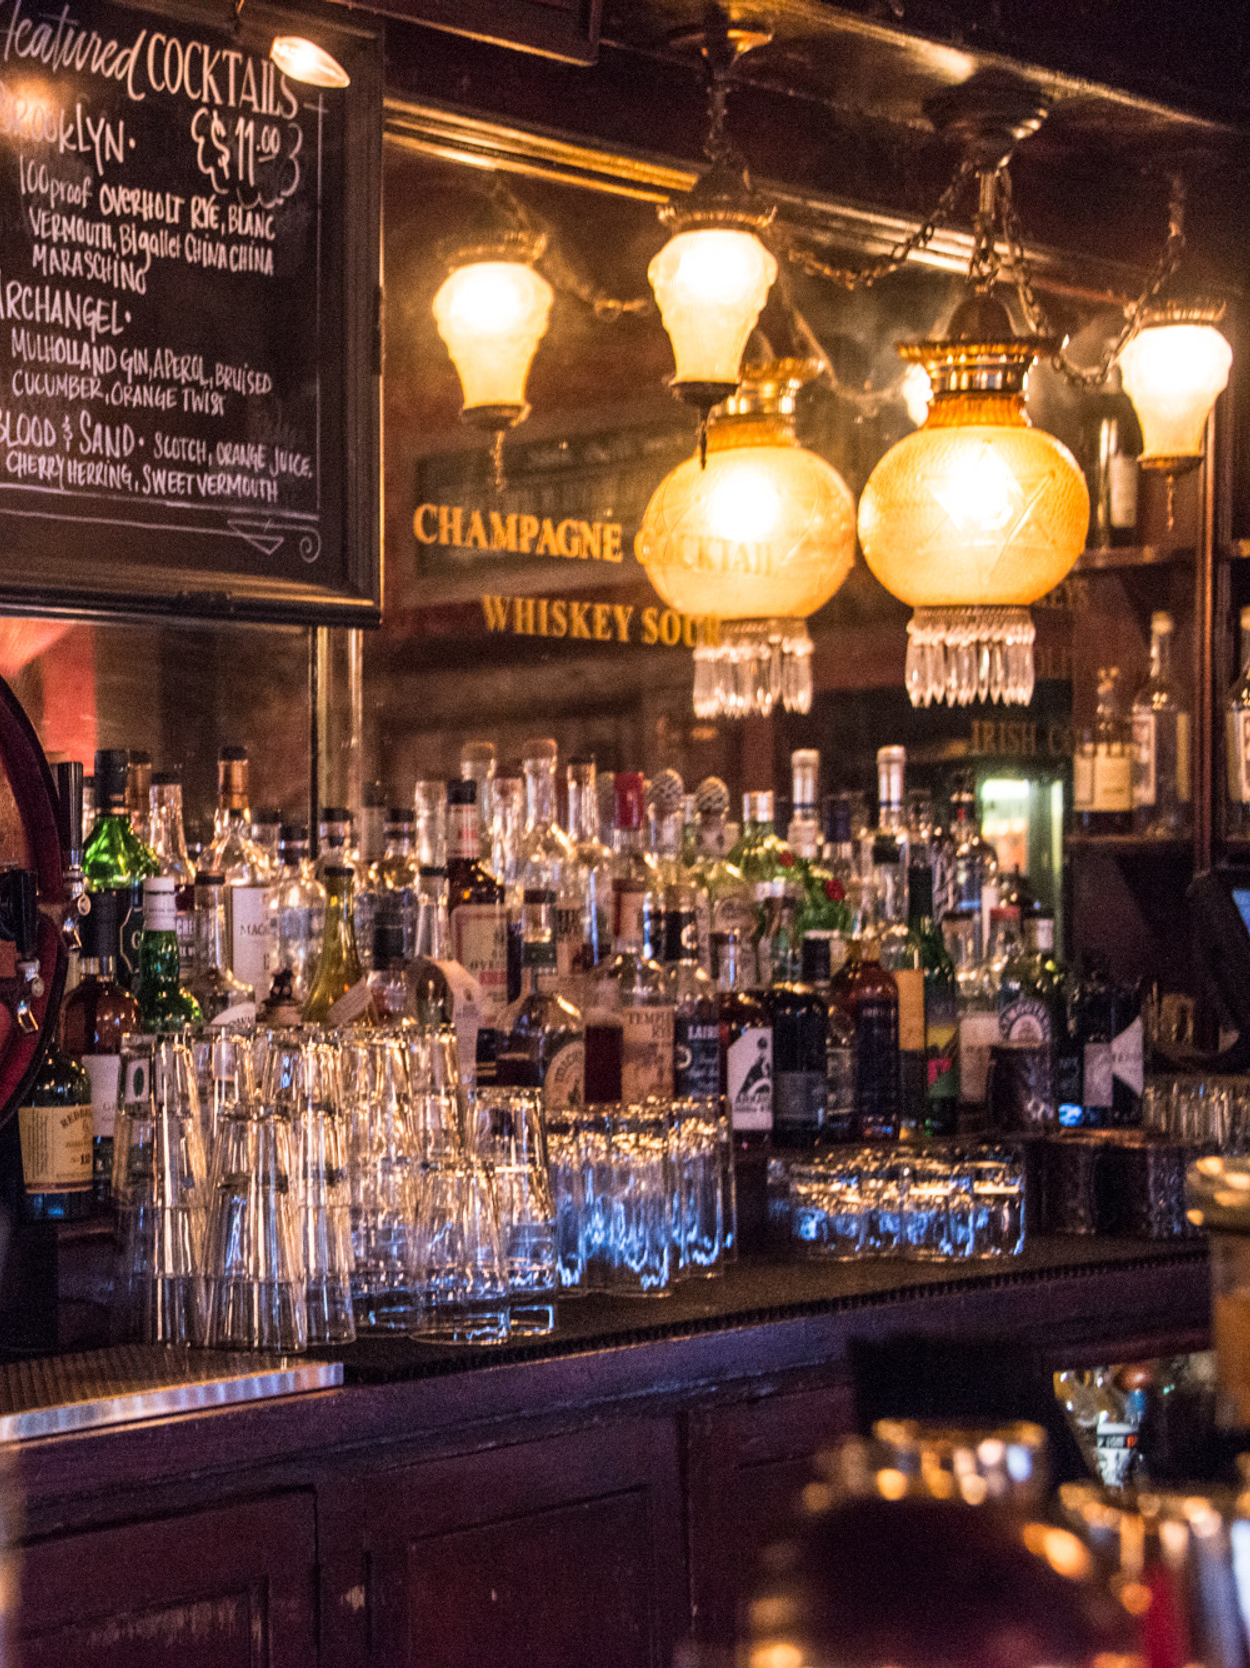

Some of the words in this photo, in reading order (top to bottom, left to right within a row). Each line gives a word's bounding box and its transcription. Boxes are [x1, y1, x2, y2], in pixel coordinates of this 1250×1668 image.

[147, 33, 299, 120] COCKTAILS
[228, 204, 276, 240] BLANC
[32, 243, 147, 295] MARASCHINO
[11, 326, 117, 377] MULHOLLAND
[215, 361, 273, 396] BRUISED
[111, 380, 178, 412] ORANGE
[182, 385, 226, 417] TWIST
[79, 409, 135, 459] SAND
[216, 441, 267, 473] ORANGE
[6, 451, 65, 491] CHERRY
[142, 463, 196, 496] SWEET
[196, 472, 278, 503] VERMOUTH
[413, 503, 623, 563] CHAMPAGNE
[483, 594, 633, 642] WHISKEY
